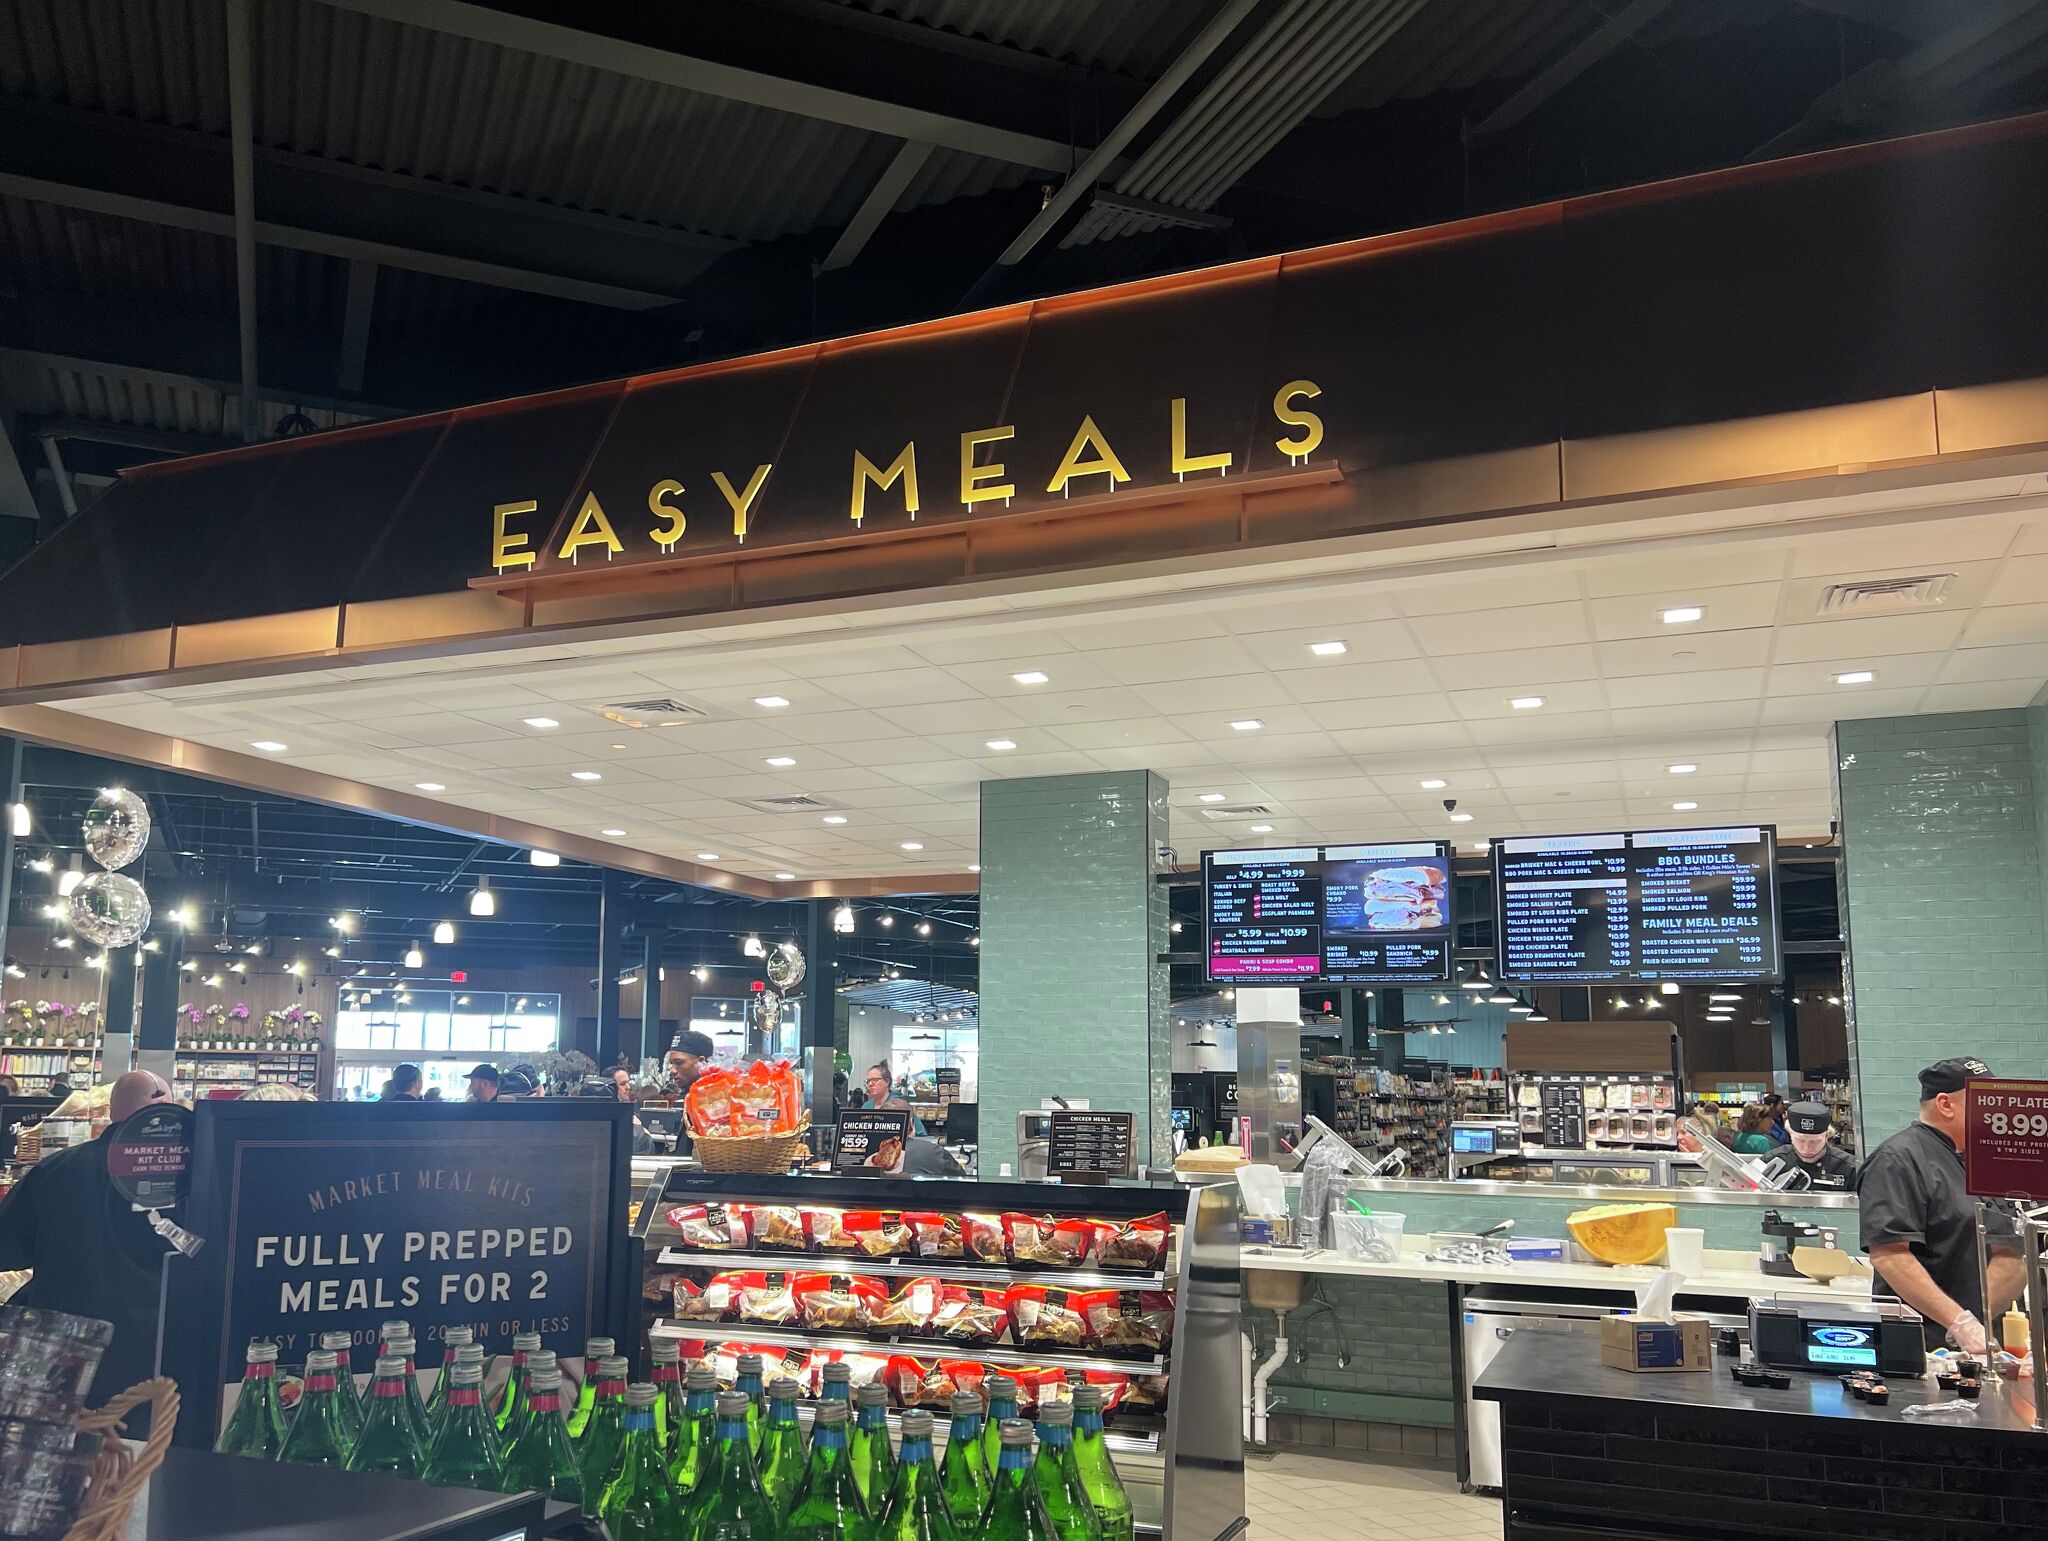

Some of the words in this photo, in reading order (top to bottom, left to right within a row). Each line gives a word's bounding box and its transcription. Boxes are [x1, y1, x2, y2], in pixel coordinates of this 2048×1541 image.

[492, 463, 772, 569] EASY
[850, 379, 1325, 521] MEALS
[1658, 857, 1681, 865] BBQ
[1685, 854, 1736, 864] BUNDLES
[1239, 870, 1263, 879] $4.99
[1643, 918, 1682, 928] FAMILY
[1686, 918, 1717, 927] MEAL
[1722, 916, 1758, 926] DEALS
[1239, 929, 1261, 938] $5.99
[1280, 928, 1307, 937] $10.99
[1978, 1096, 2004, 1106] HOT
[1984, 1113, 2048, 1137] $8.99
[841, 1137, 868, 1148] $15.99
[308, 1172, 401, 1213] MARKET
[418, 1169, 474, 1193] MEAL
[488, 1178, 535, 1208] KITS
[255, 1233, 385, 1268] FULLY
[404, 1226, 573, 1261] PREPPED
[279, 1276, 420, 1313] MEALS
[440, 1271, 510, 1305] FOR
[530, 1270, 548, 1300] 2
[427, 1326, 448, 1341] 20
[500, 1320, 520, 1336] OR
[532, 1316, 570, 1334] LESS
